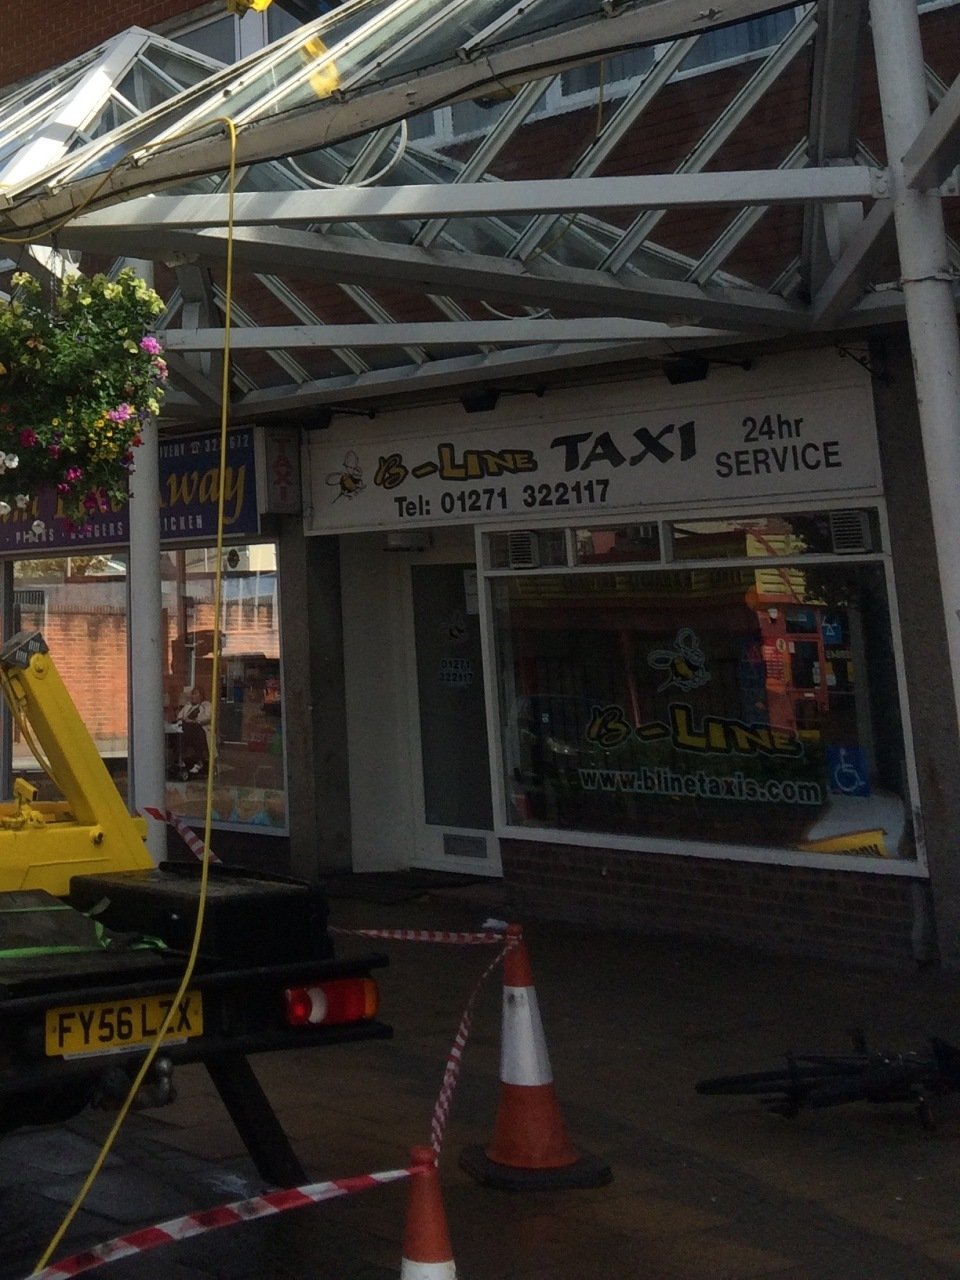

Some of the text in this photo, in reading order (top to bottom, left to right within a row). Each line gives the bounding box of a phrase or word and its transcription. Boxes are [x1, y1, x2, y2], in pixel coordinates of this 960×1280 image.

[550, 421, 697, 472] TAXI
[742, 415, 803, 443] 24hr
[715, 440, 842, 478] SERVICE
[160, 464, 246, 525] way
[394, 479, 611, 518] Tel: 01271 322117
[163, 514, 203, 531] ICKEN
[578, 767, 822, 805] www.blinetaxis.com
[58, 997, 192, 1047] FY56 LZX
